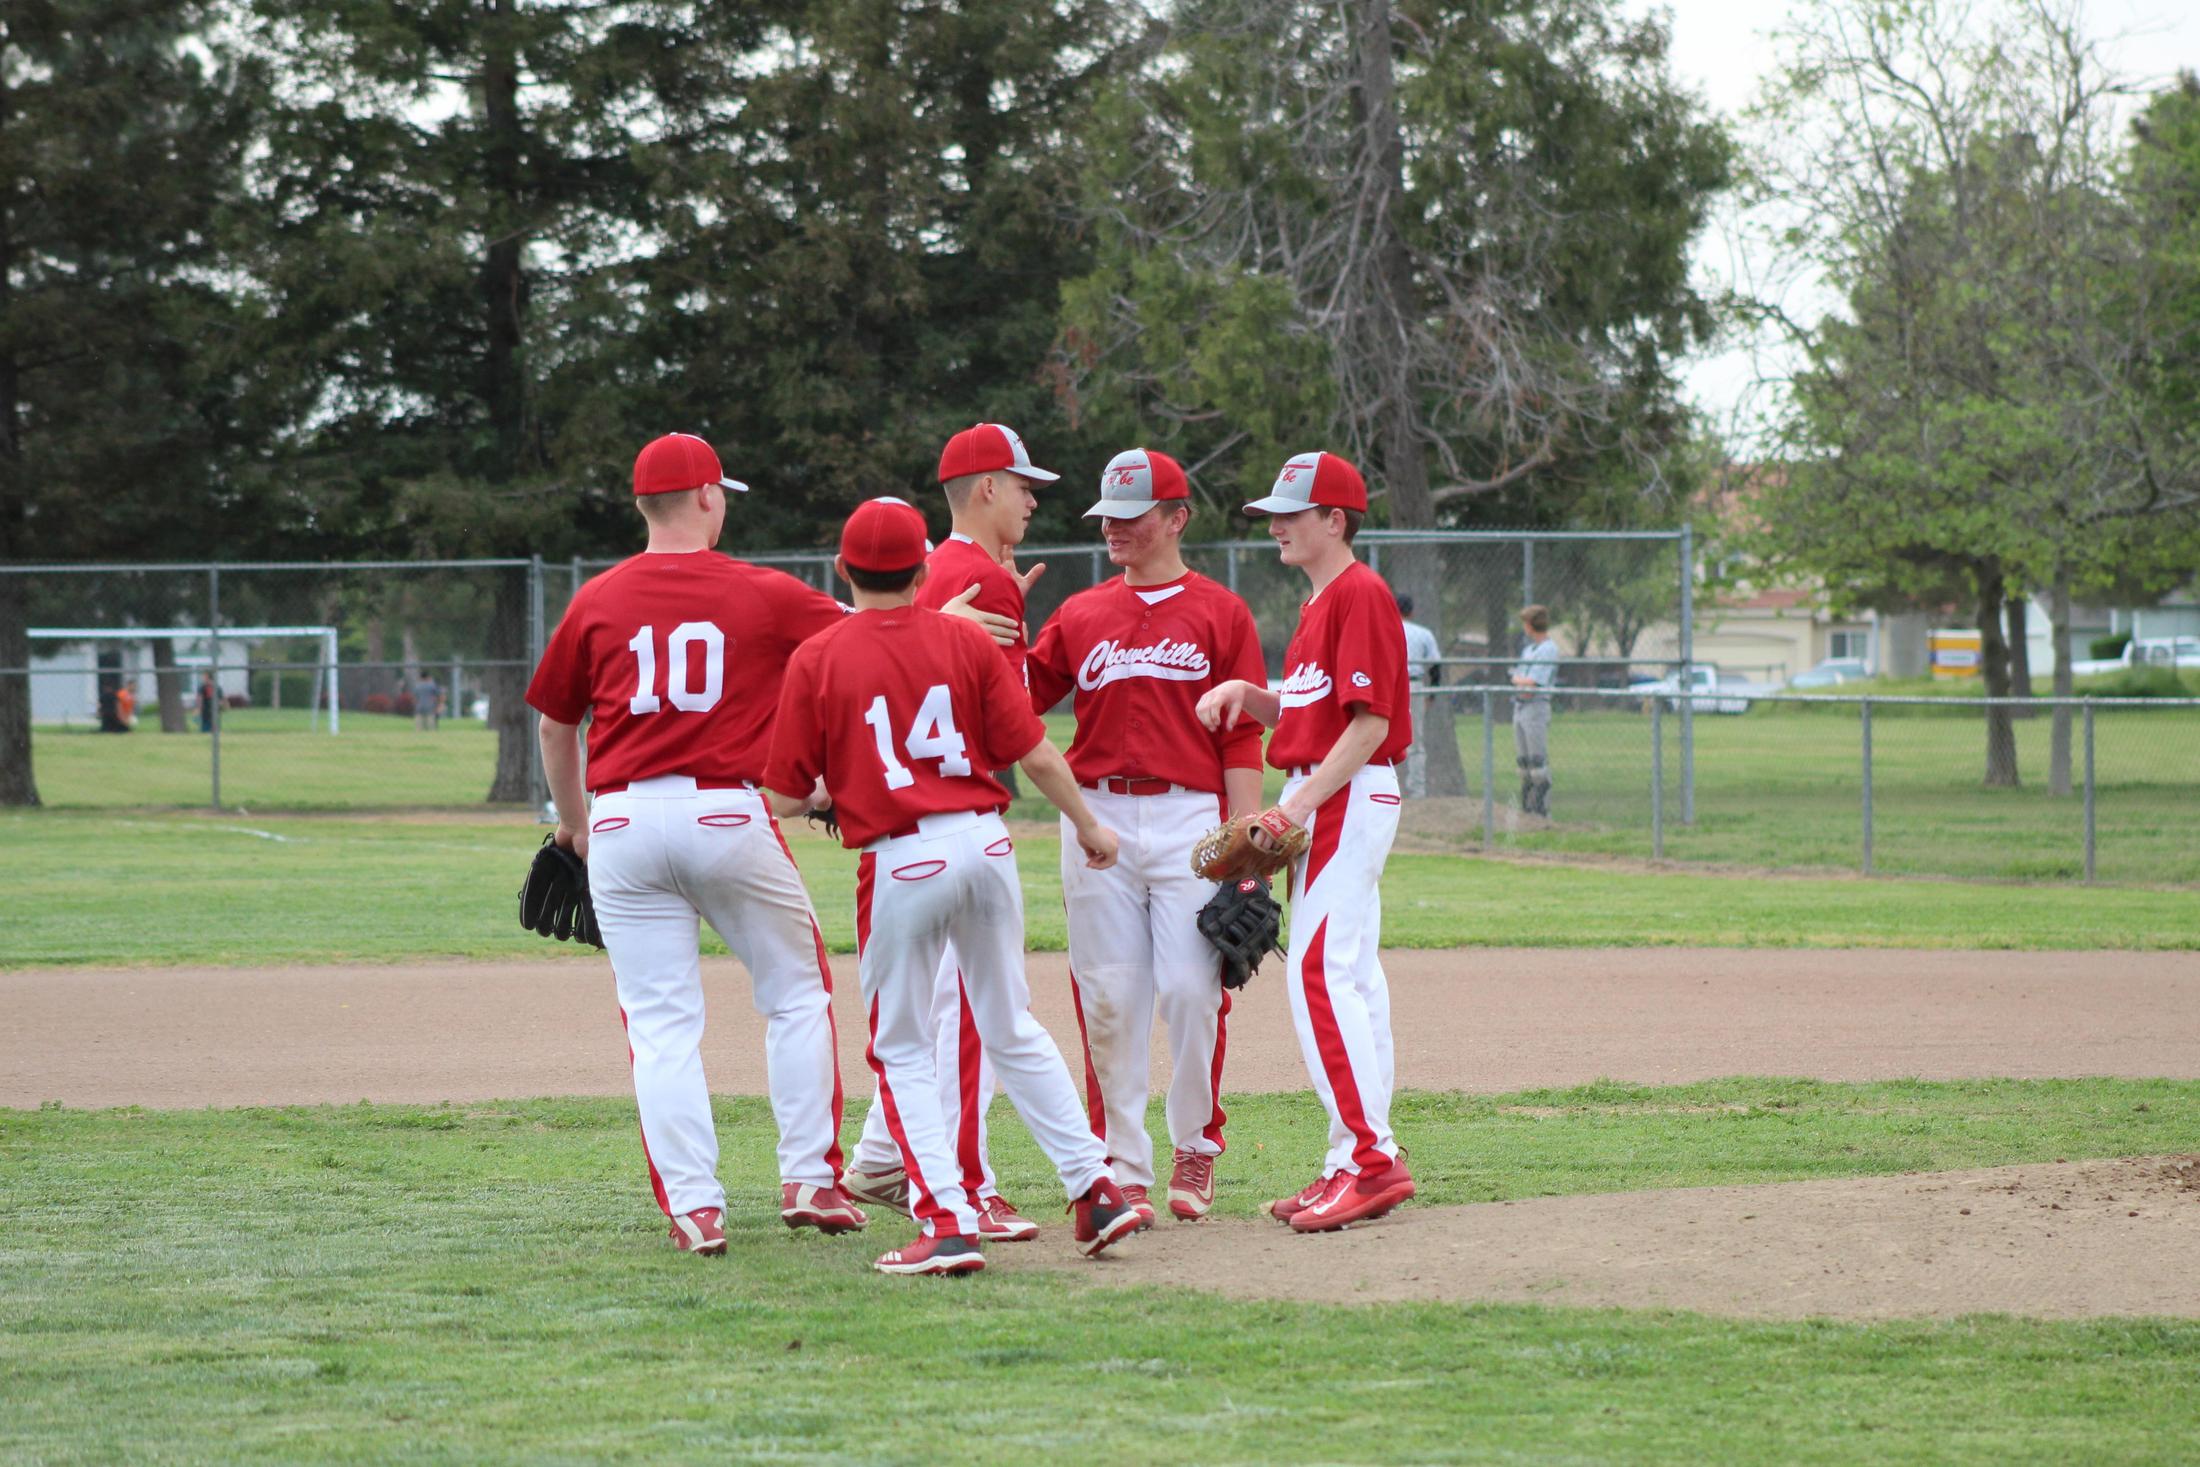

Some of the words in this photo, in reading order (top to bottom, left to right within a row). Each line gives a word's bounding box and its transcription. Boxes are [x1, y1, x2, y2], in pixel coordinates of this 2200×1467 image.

[628, 621, 725, 715] 10
[1078, 638, 1210, 691] Chowchilla
[865, 684, 972, 791] 14
